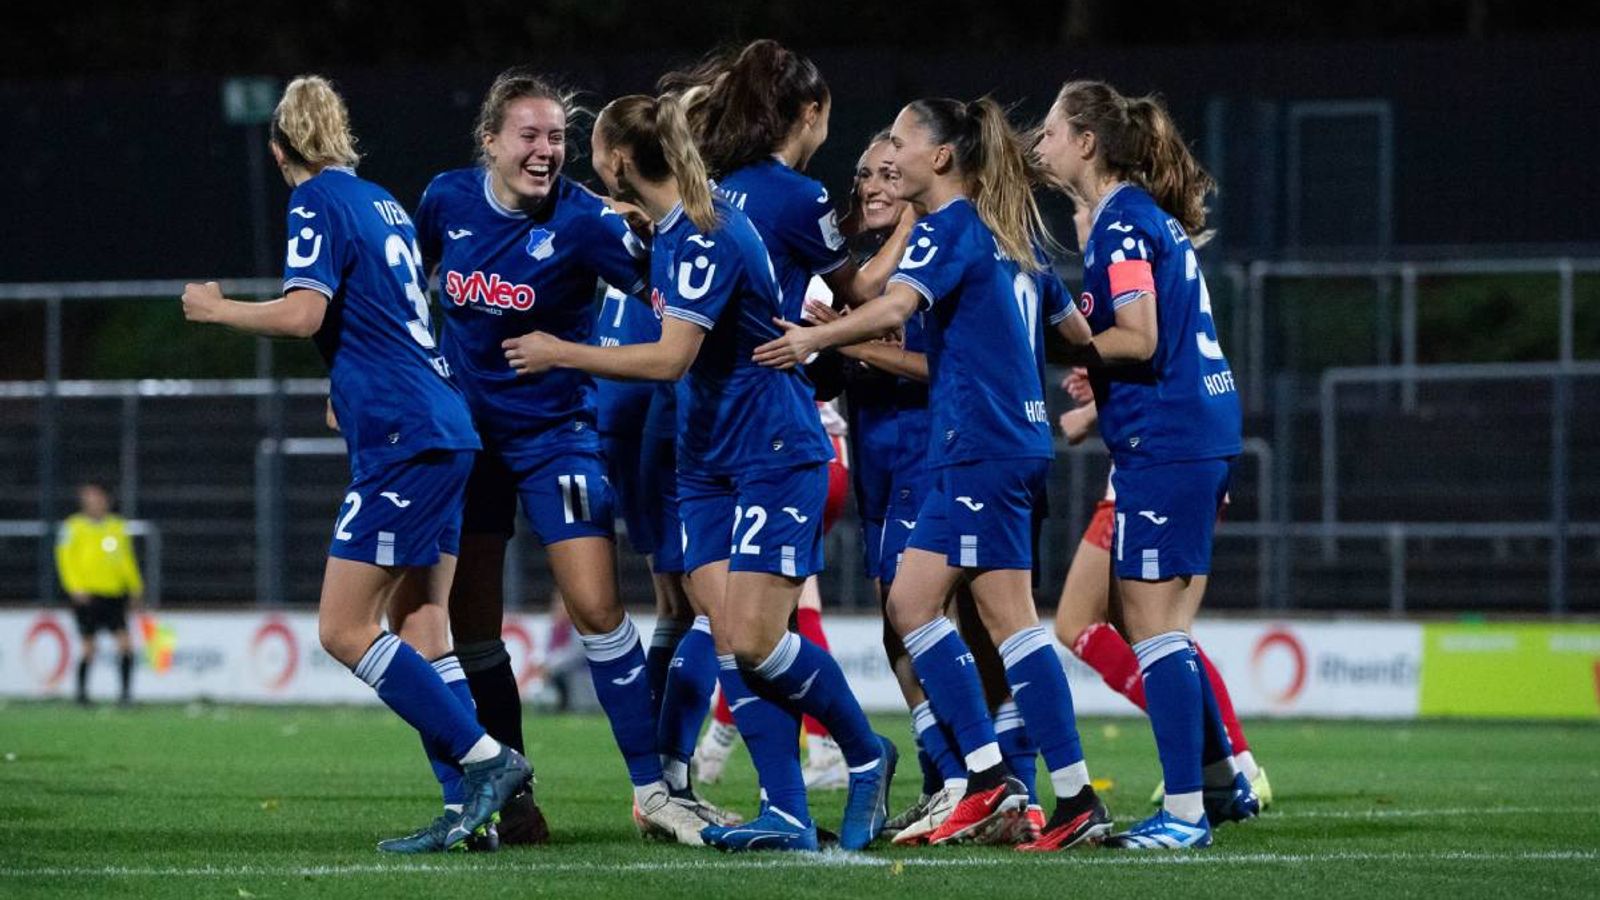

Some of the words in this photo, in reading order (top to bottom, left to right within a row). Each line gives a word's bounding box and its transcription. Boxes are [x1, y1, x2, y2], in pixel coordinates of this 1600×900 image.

[384, 233, 437, 349] 3
[446, 271, 535, 311] syNeo
[333, 491, 363, 541] 2
[558, 474, 591, 524] 11
